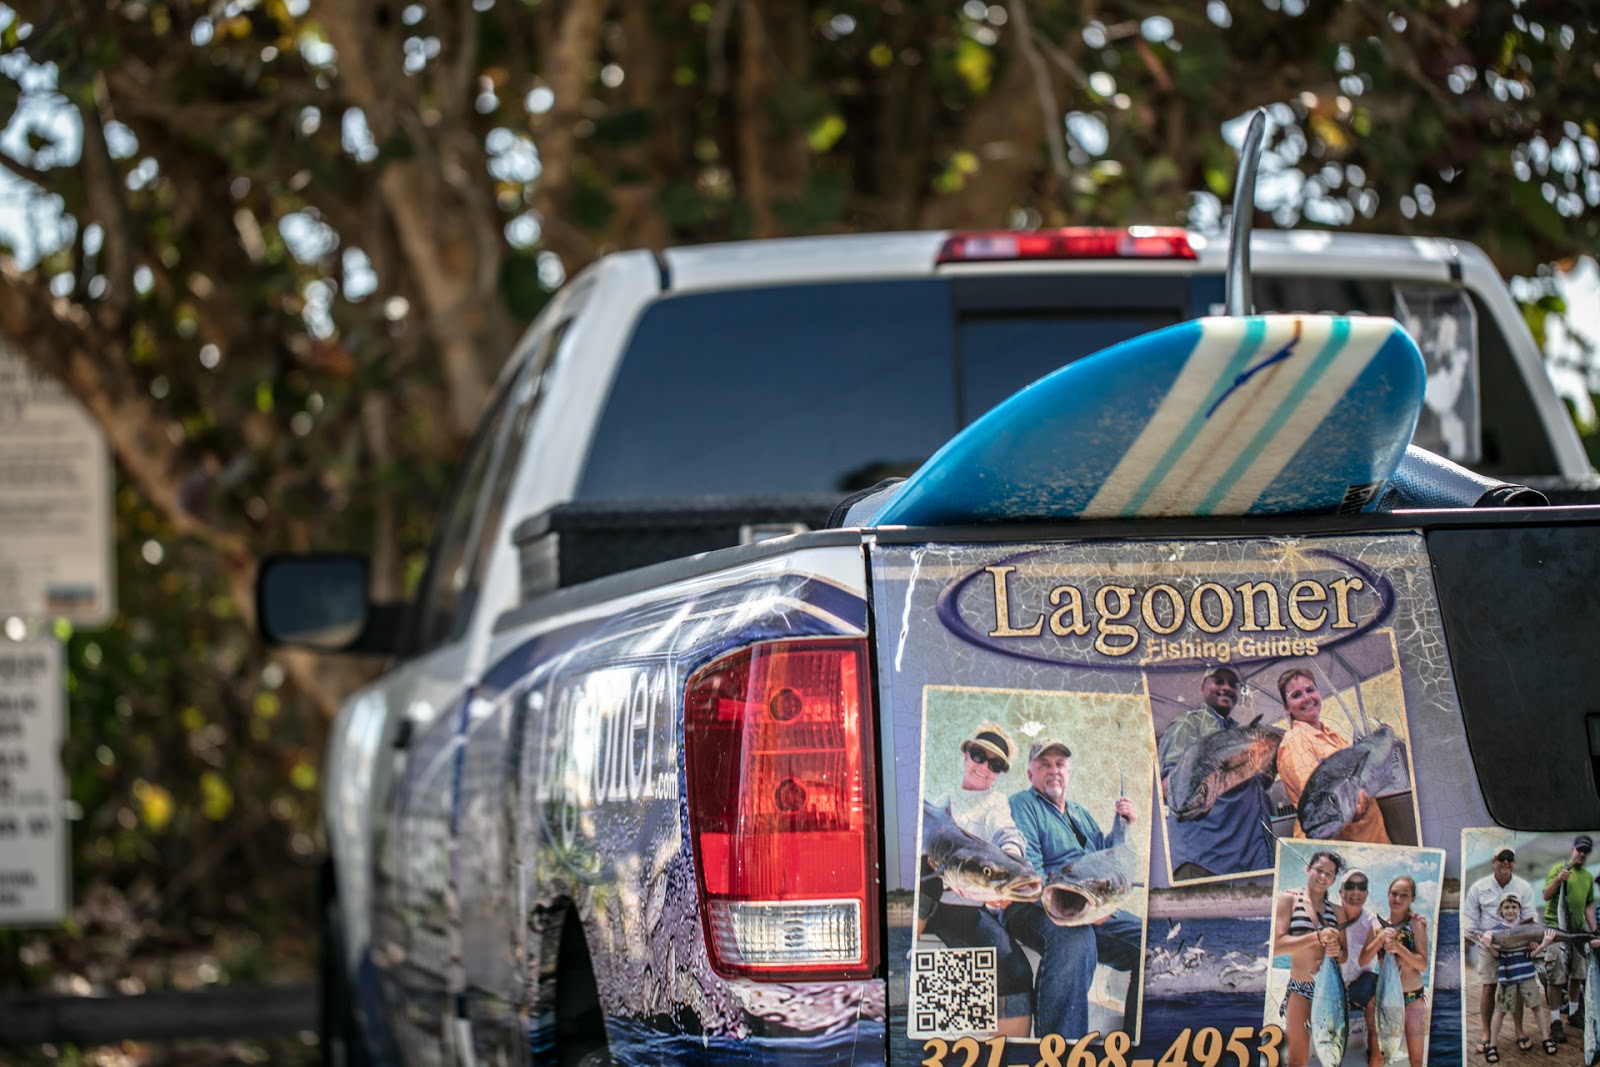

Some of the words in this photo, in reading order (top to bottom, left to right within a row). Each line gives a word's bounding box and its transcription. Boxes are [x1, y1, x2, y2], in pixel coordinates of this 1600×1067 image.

[984, 564, 1364, 656] Lagooner
[1146, 638, 1231, 663] Fishing
[1238, 636, 1319, 657] Guides
